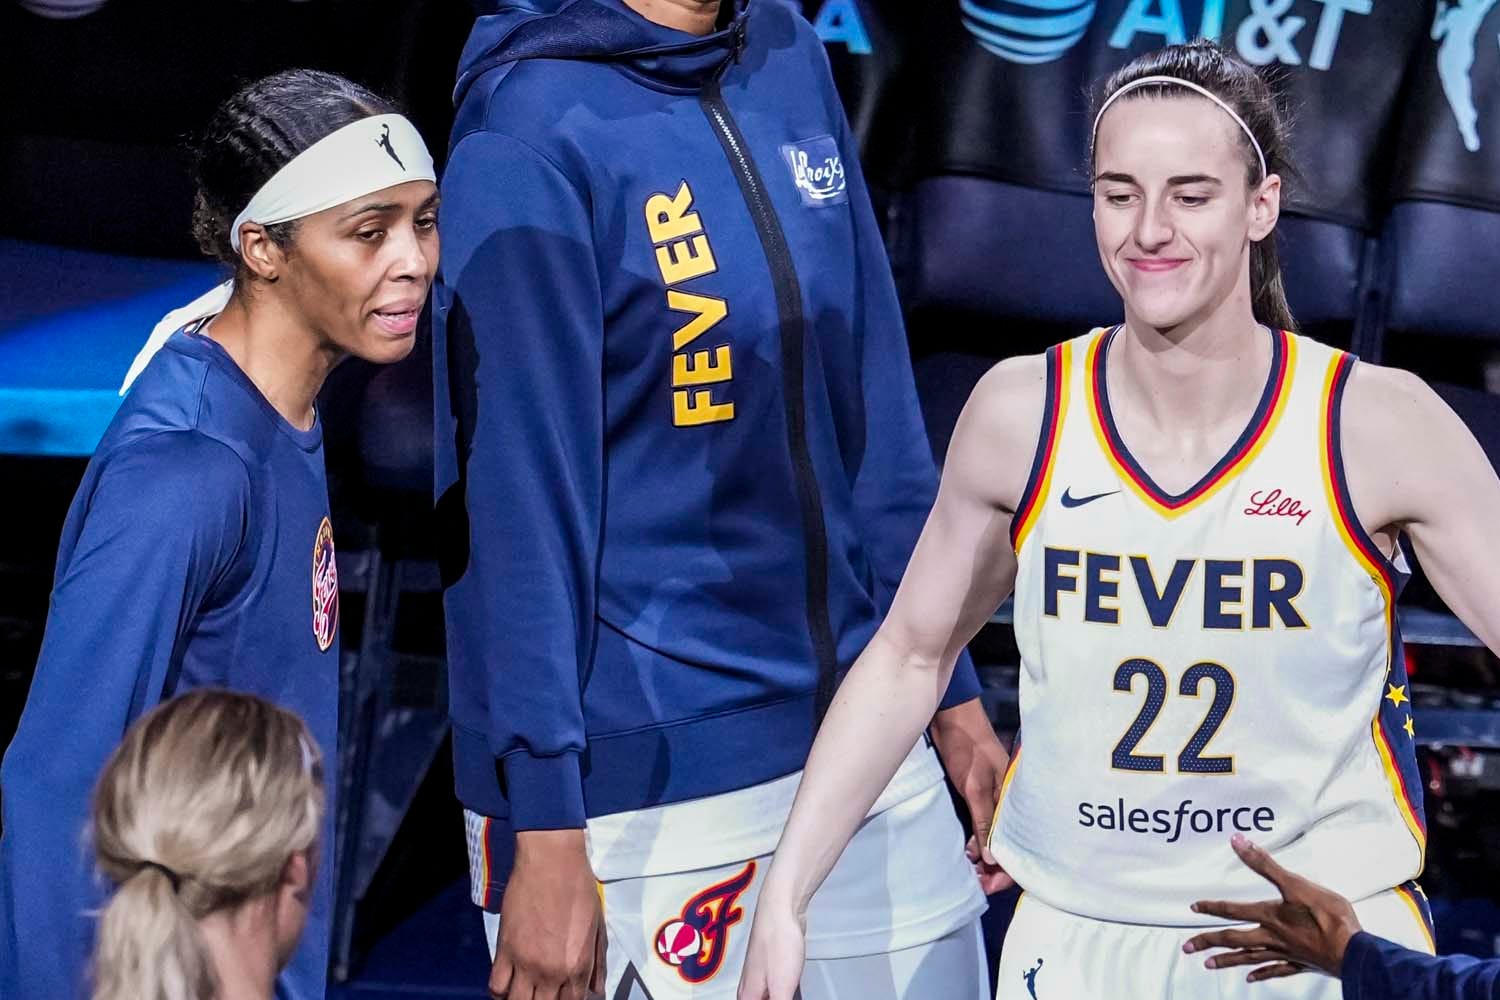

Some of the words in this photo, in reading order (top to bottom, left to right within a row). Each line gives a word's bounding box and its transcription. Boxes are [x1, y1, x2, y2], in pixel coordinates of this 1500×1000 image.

[644, 178, 736, 428] FEVER
[1243, 488, 1312, 526] Lilly
[1042, 546, 1312, 631] FEVER
[1110, 655, 1237, 775] 22
[1078, 798, 1275, 842] salesforce
